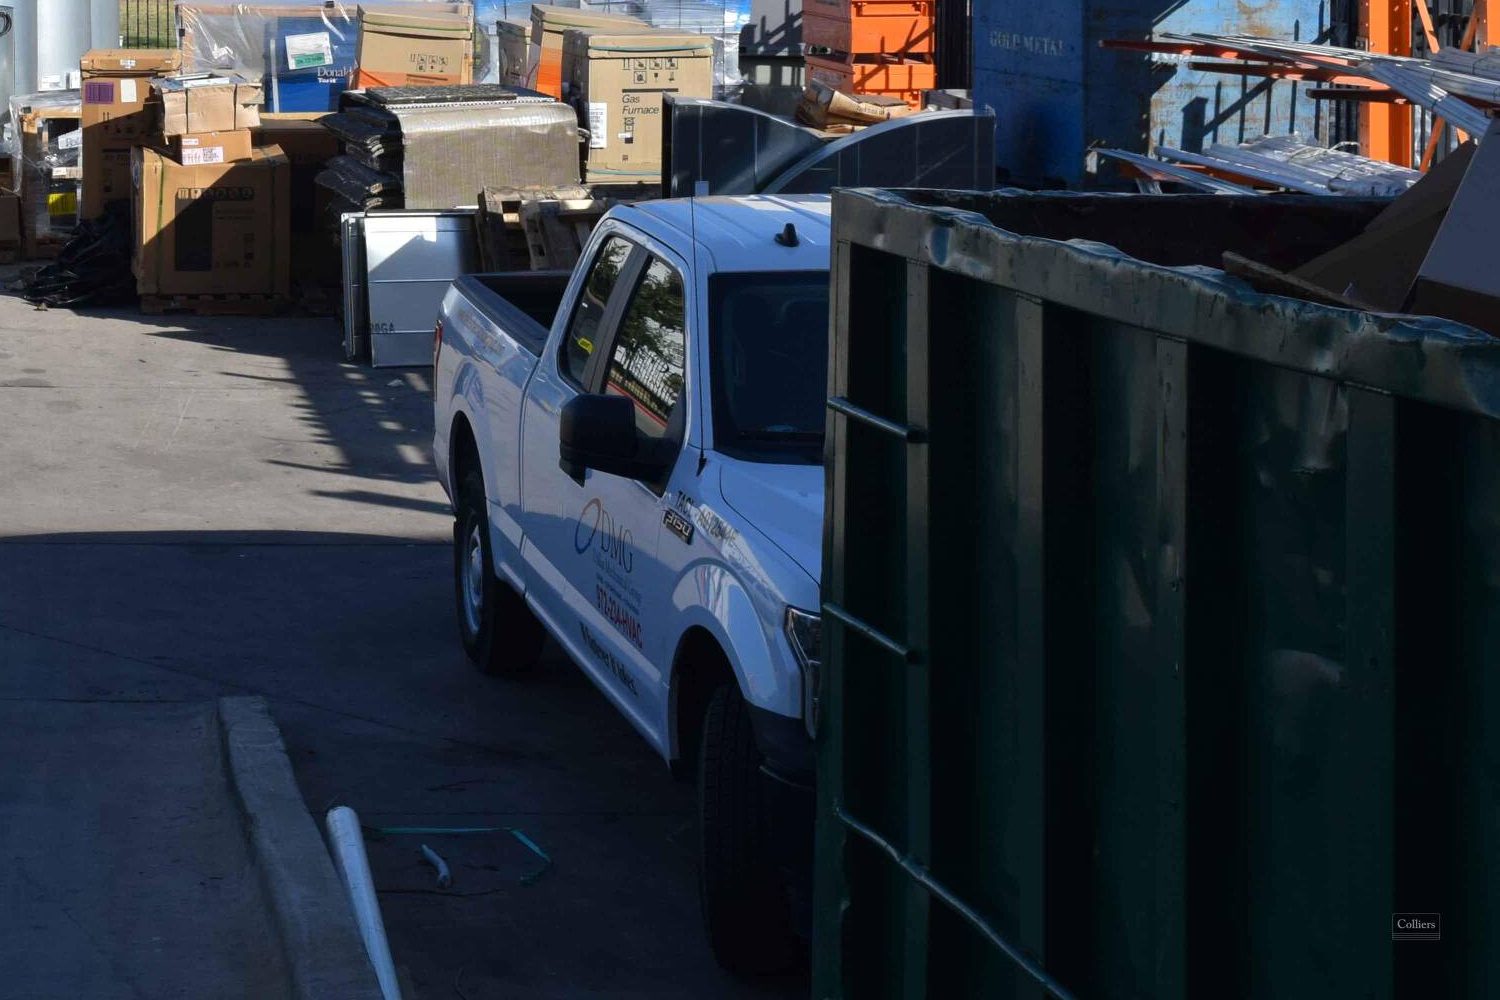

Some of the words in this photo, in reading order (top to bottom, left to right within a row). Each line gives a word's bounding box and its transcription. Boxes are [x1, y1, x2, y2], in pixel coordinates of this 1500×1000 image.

[621, 94, 641, 104] Gas
[621, 105, 660, 115] Furnace
[601, 508, 633, 574] DMG
